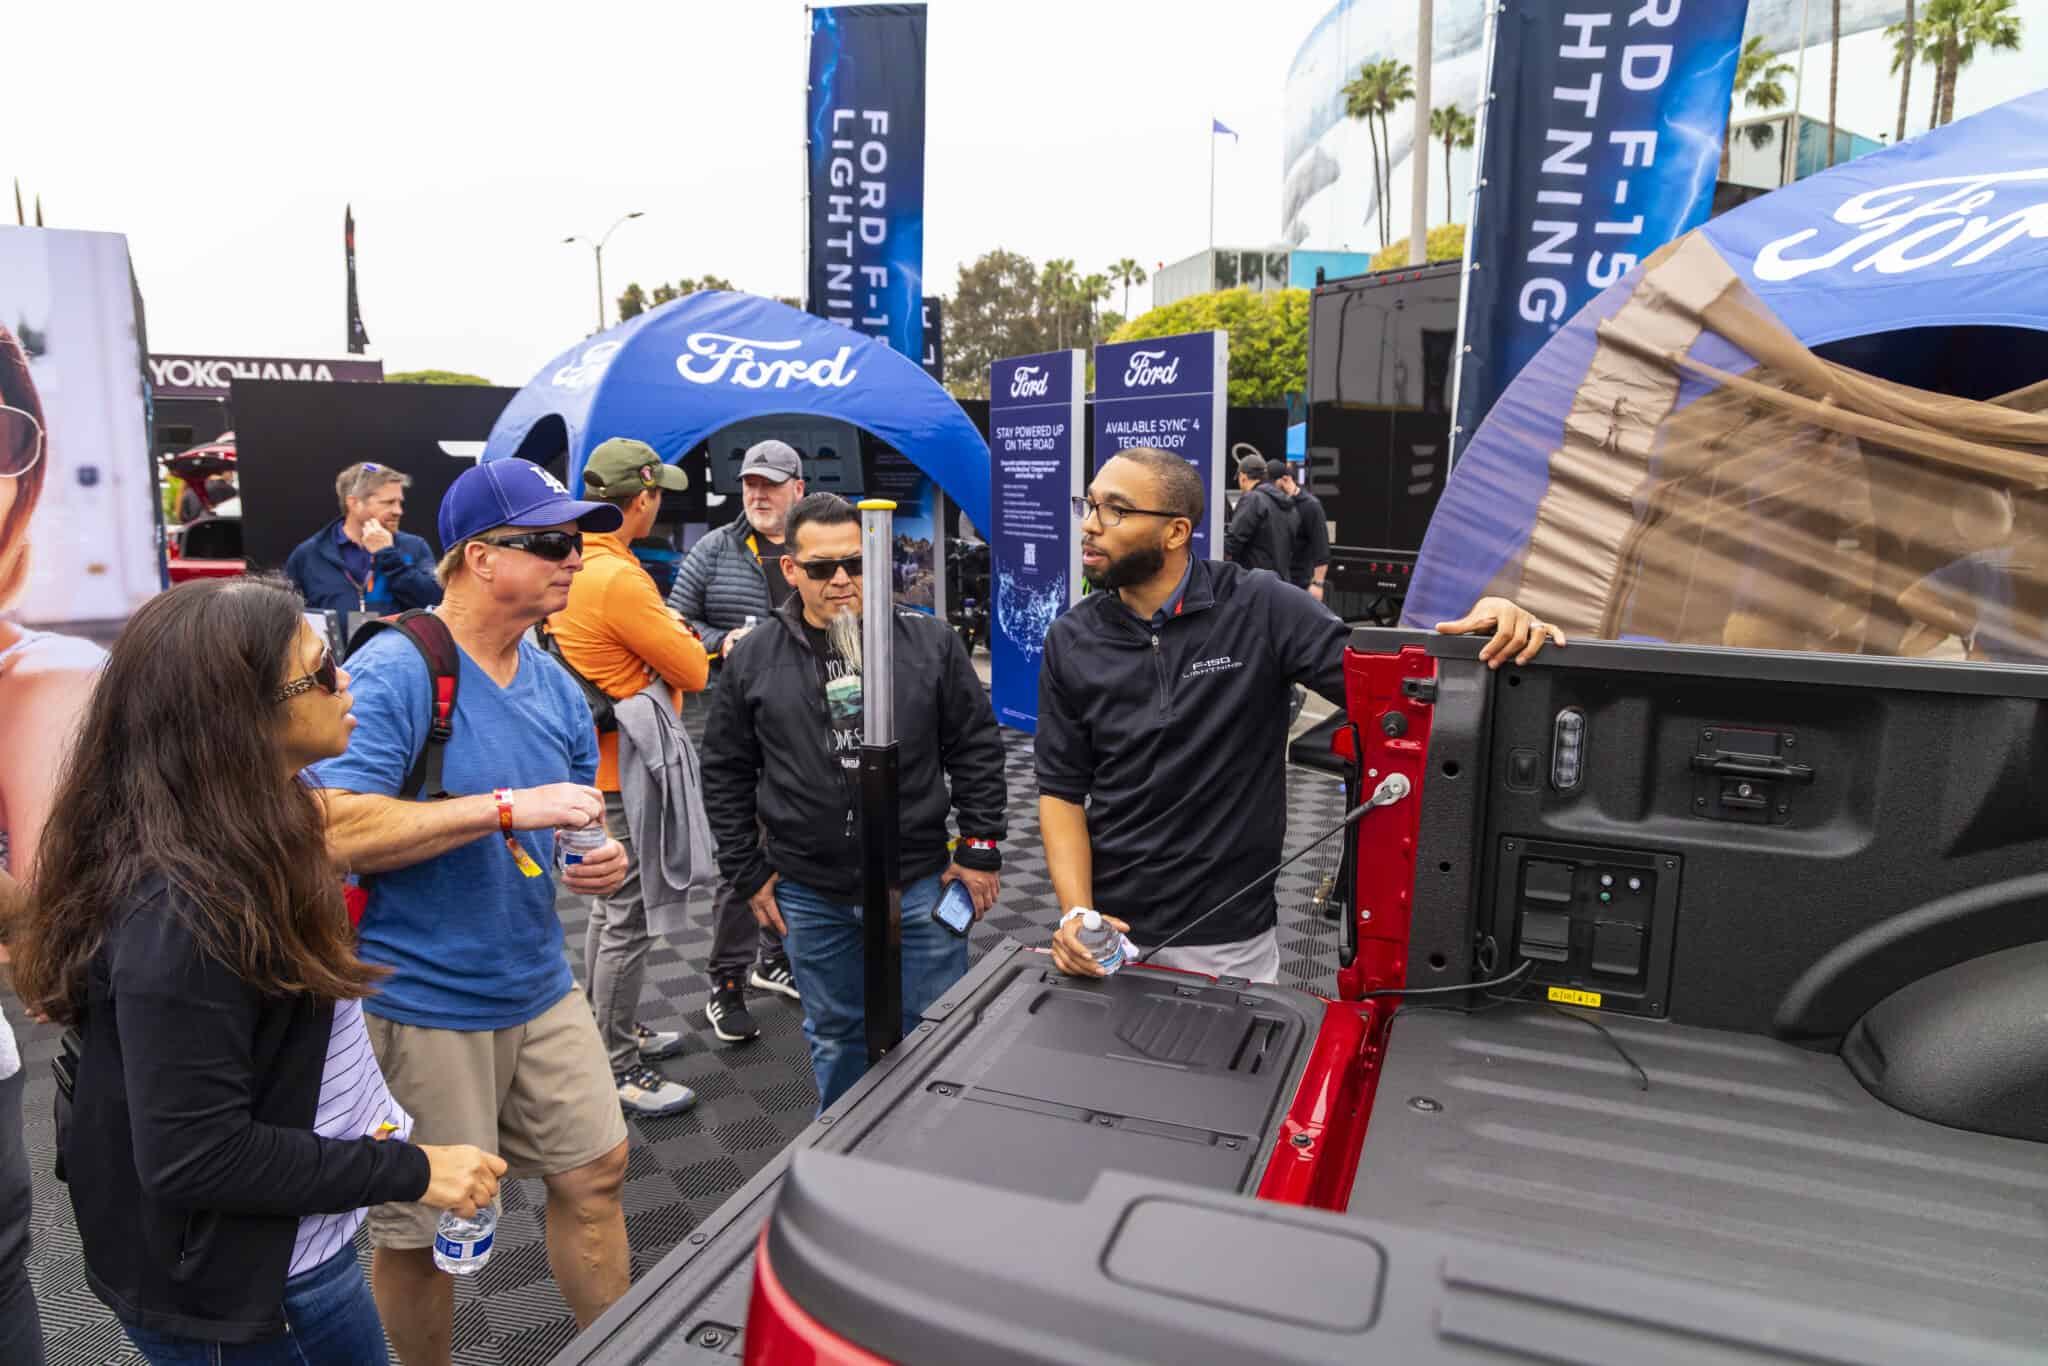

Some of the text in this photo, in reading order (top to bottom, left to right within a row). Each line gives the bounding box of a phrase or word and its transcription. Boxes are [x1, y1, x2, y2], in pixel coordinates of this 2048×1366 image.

[860, 110, 889, 245] FORD
[1519, 13, 1612, 323] HTNING
[149, 359, 333, 388] YOKOHAMA
[676, 332, 858, 388] Ford
[1124, 351, 1180, 388] Ford
[1011, 366, 1049, 398] Ford
[996, 423, 1065, 440] STAY POWERED UP
[1105, 420, 1157, 434] AVAILABLE
[1192, 417, 1201, 431] 4
[1005, 438, 1055, 451] ON THE ROAD
[1117, 434, 1187, 449] TECHNOLOGY
[1192, 656, 1231, 671] F-150
